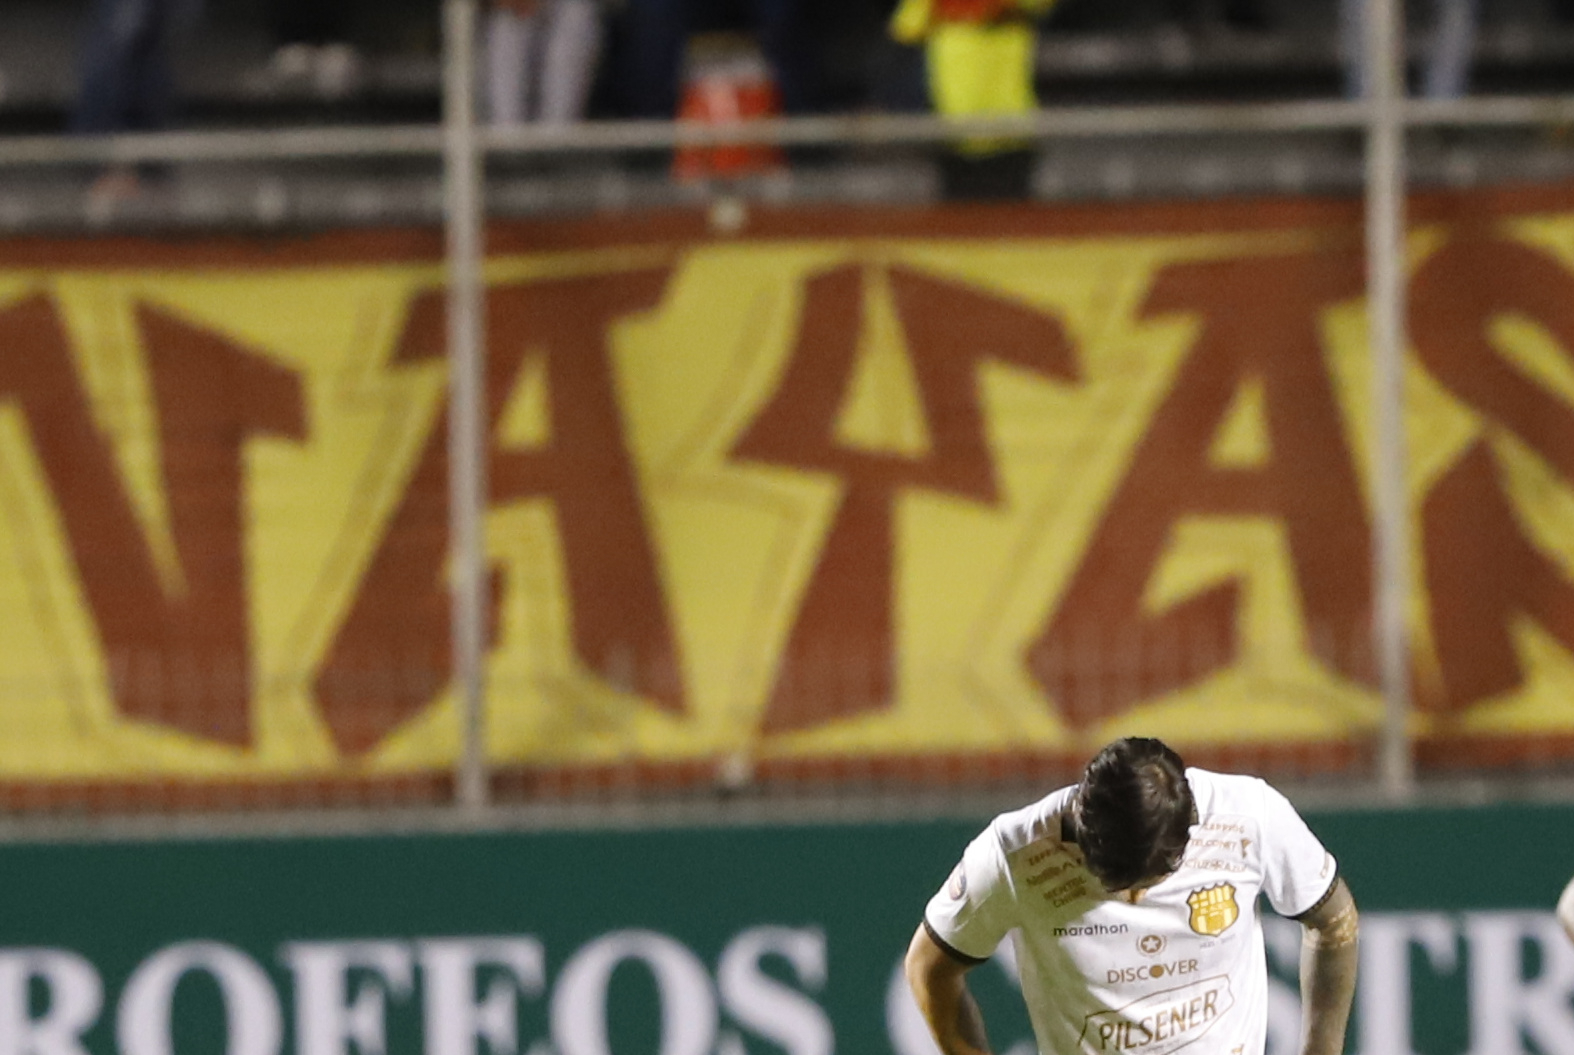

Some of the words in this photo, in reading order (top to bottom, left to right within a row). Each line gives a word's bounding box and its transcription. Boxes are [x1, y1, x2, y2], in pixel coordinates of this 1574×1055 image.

[1053, 923, 1129, 937] marathon
[1107, 958, 1199, 984] DISCOVER
[1099, 989, 1219, 1051] PILSENER
